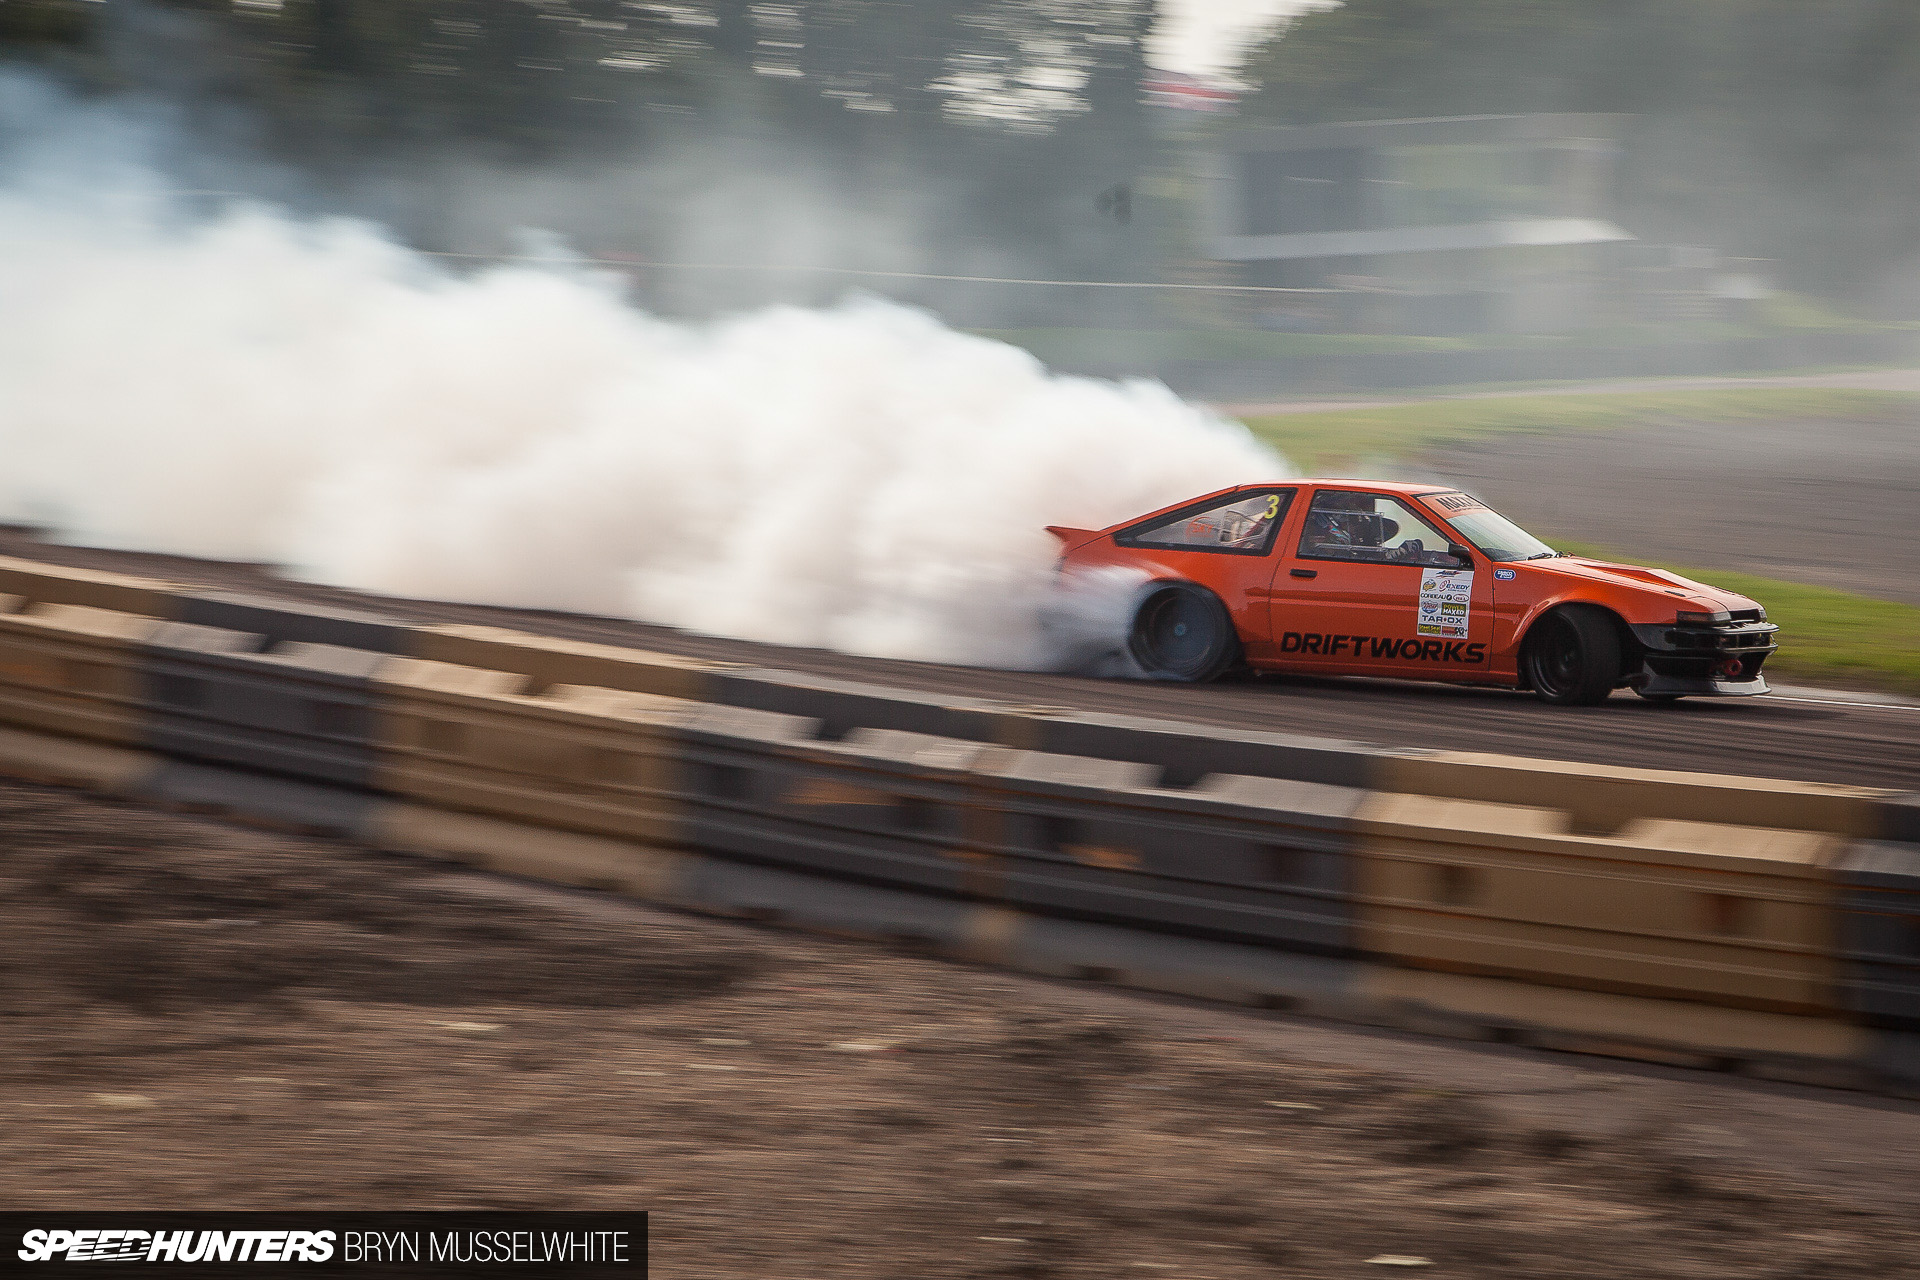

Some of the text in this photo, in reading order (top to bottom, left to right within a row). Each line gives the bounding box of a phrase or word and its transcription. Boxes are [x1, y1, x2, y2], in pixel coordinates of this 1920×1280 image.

[1264, 494, 1280, 519] 3
[1435, 495, 1482, 511] MAXX
[1281, 631, 1488, 664] DRIFTWORKS
